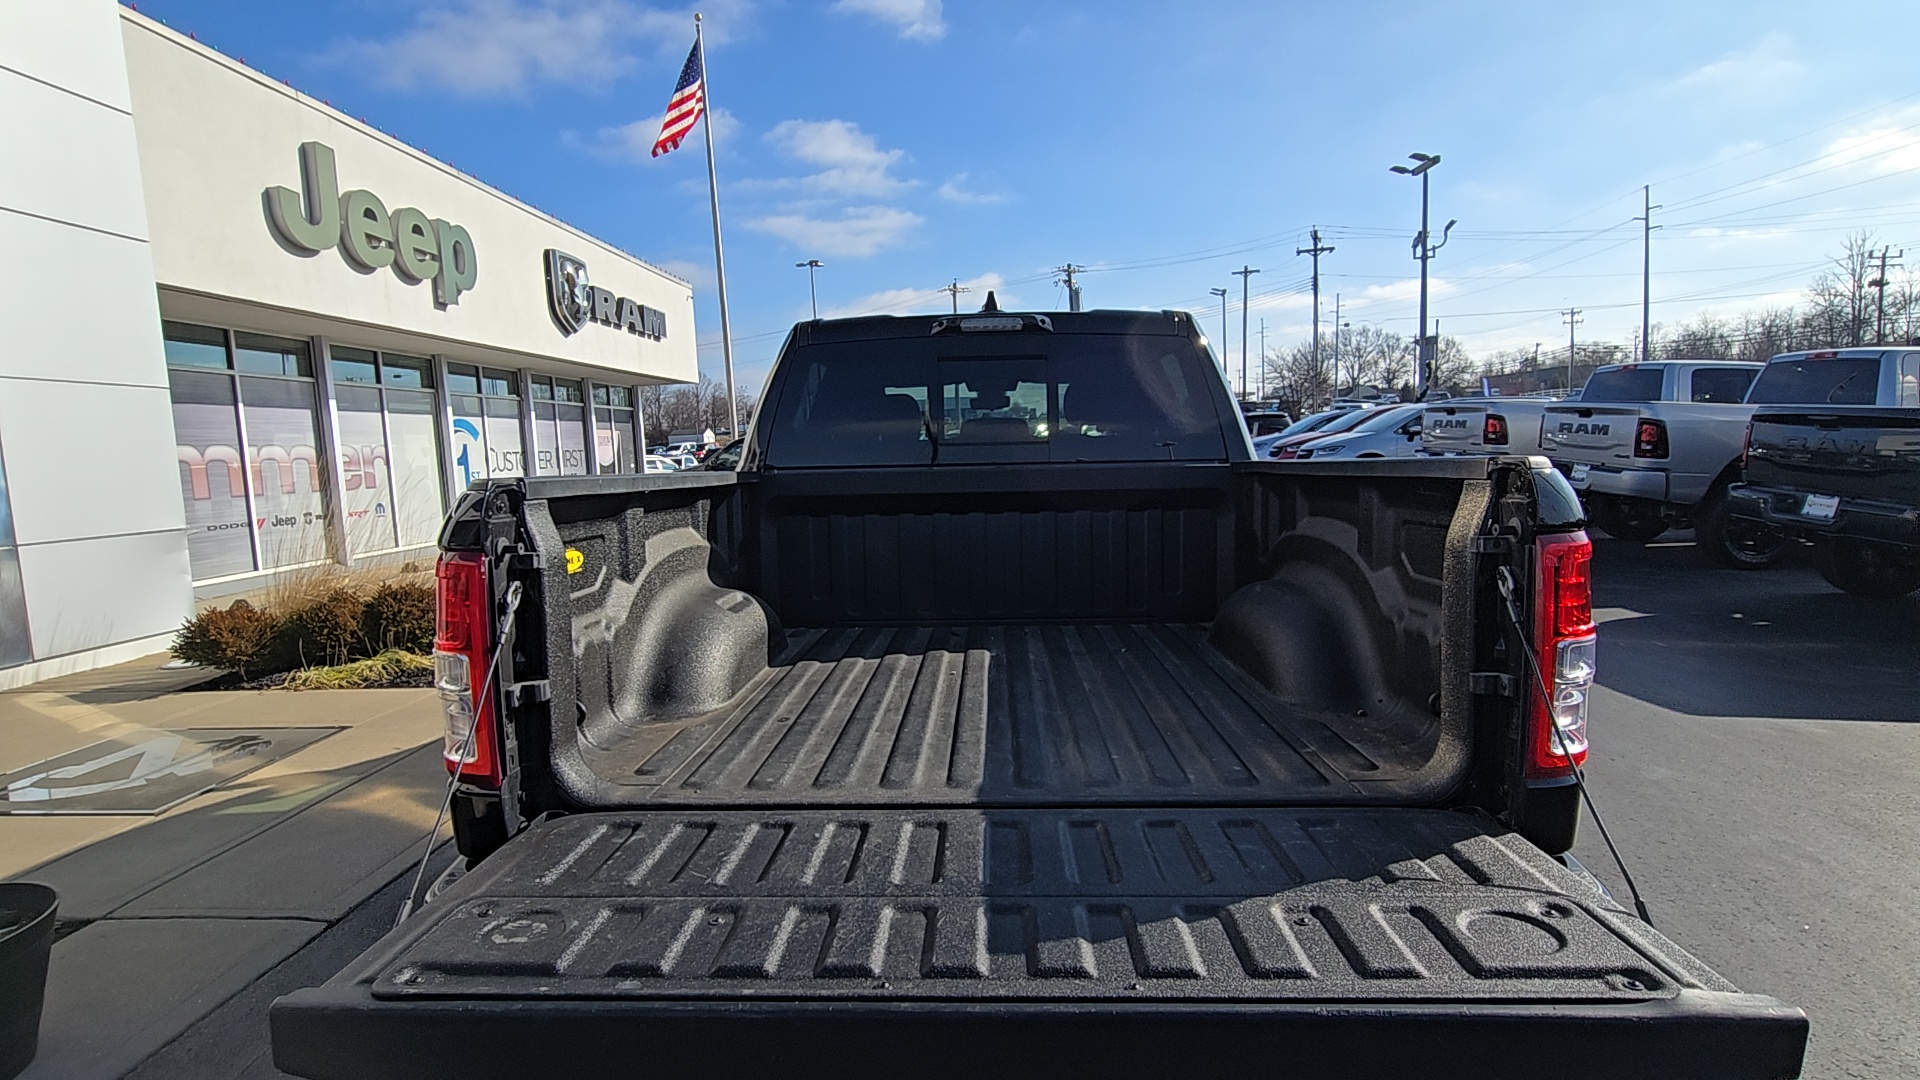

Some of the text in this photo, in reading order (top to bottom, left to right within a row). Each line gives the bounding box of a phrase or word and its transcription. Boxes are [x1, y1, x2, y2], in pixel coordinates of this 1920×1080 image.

[261, 141, 477, 311] Jeep
[587, 285, 668, 342] RAM
[1433, 419, 1467, 429] RAM
[1558, 422, 1611, 436] RAM
[1783, 436, 1876, 455] RAM
[271, 514, 297, 528] Jeep
